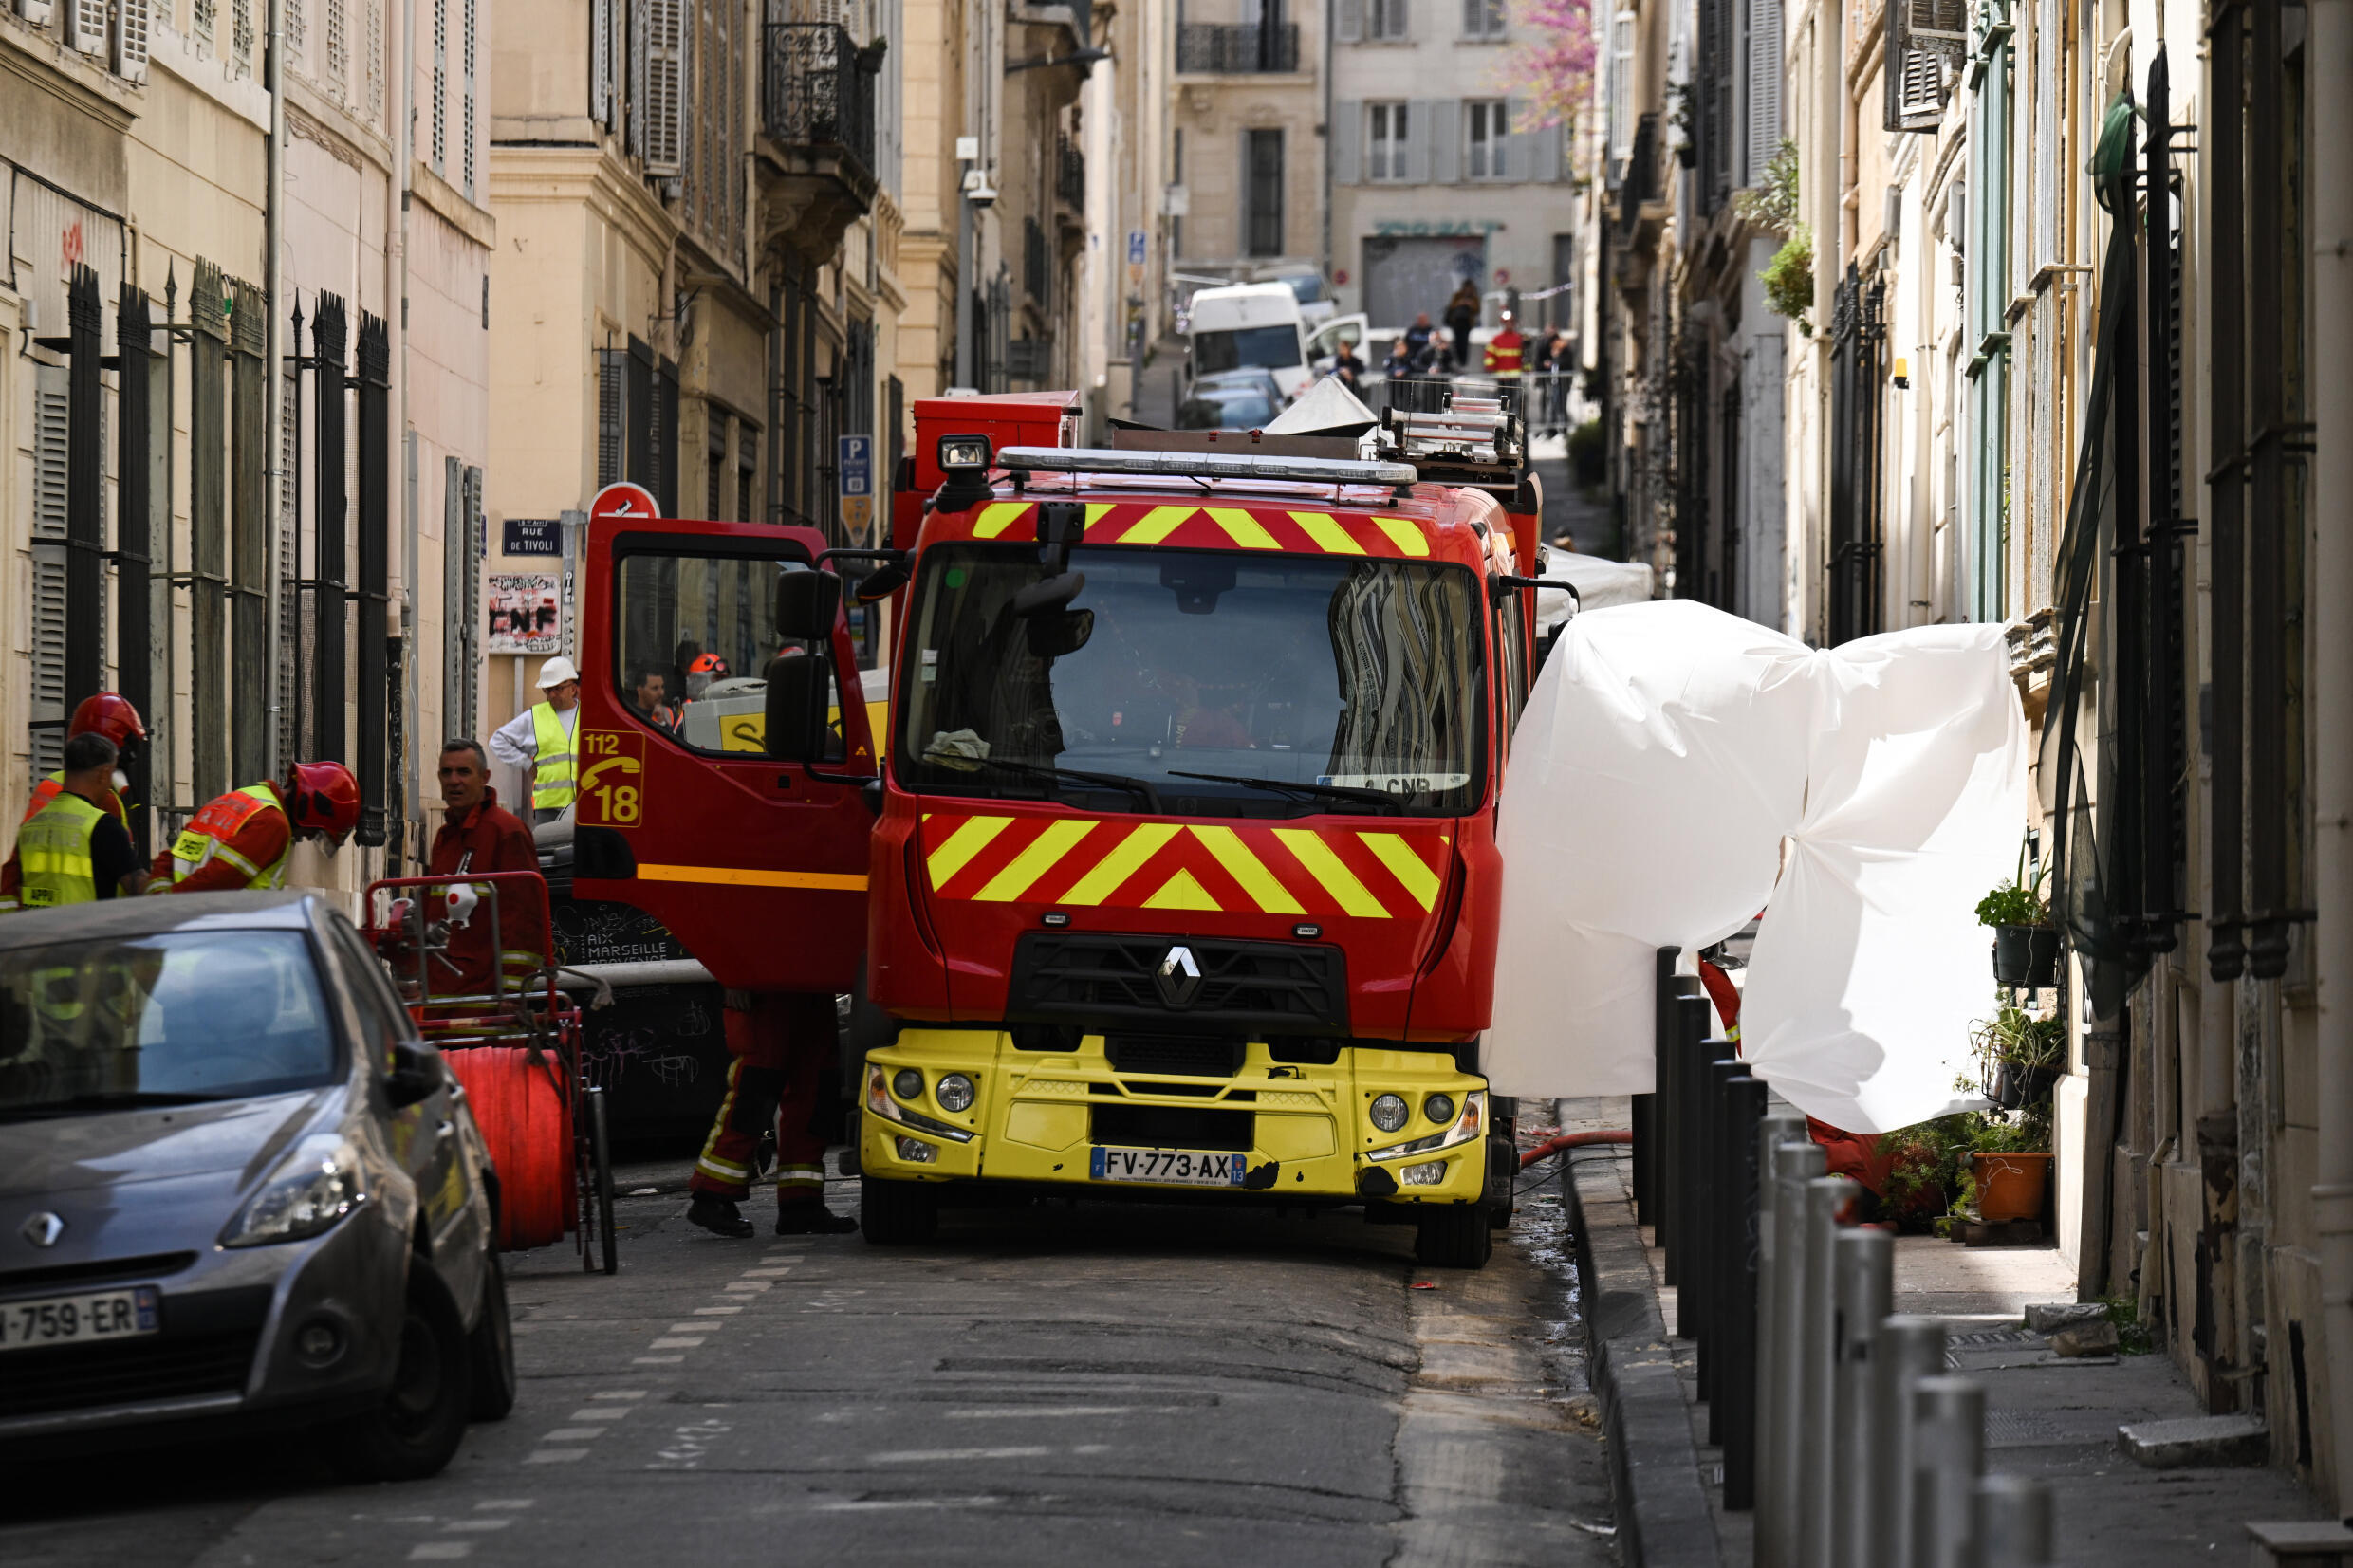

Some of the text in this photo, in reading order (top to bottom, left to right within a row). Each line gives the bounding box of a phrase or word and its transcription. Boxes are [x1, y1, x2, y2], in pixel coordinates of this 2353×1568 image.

[849, 439, 862, 459] P
[522, 527, 544, 536] RUE
[510, 540, 553, 551] DE TIVOLI
[584, 733, 620, 755] 112
[593, 784, 639, 822] 18
[1106, 1152, 1230, 1179] FV-773-AX
[1232, 1170, 1244, 1183] 13
